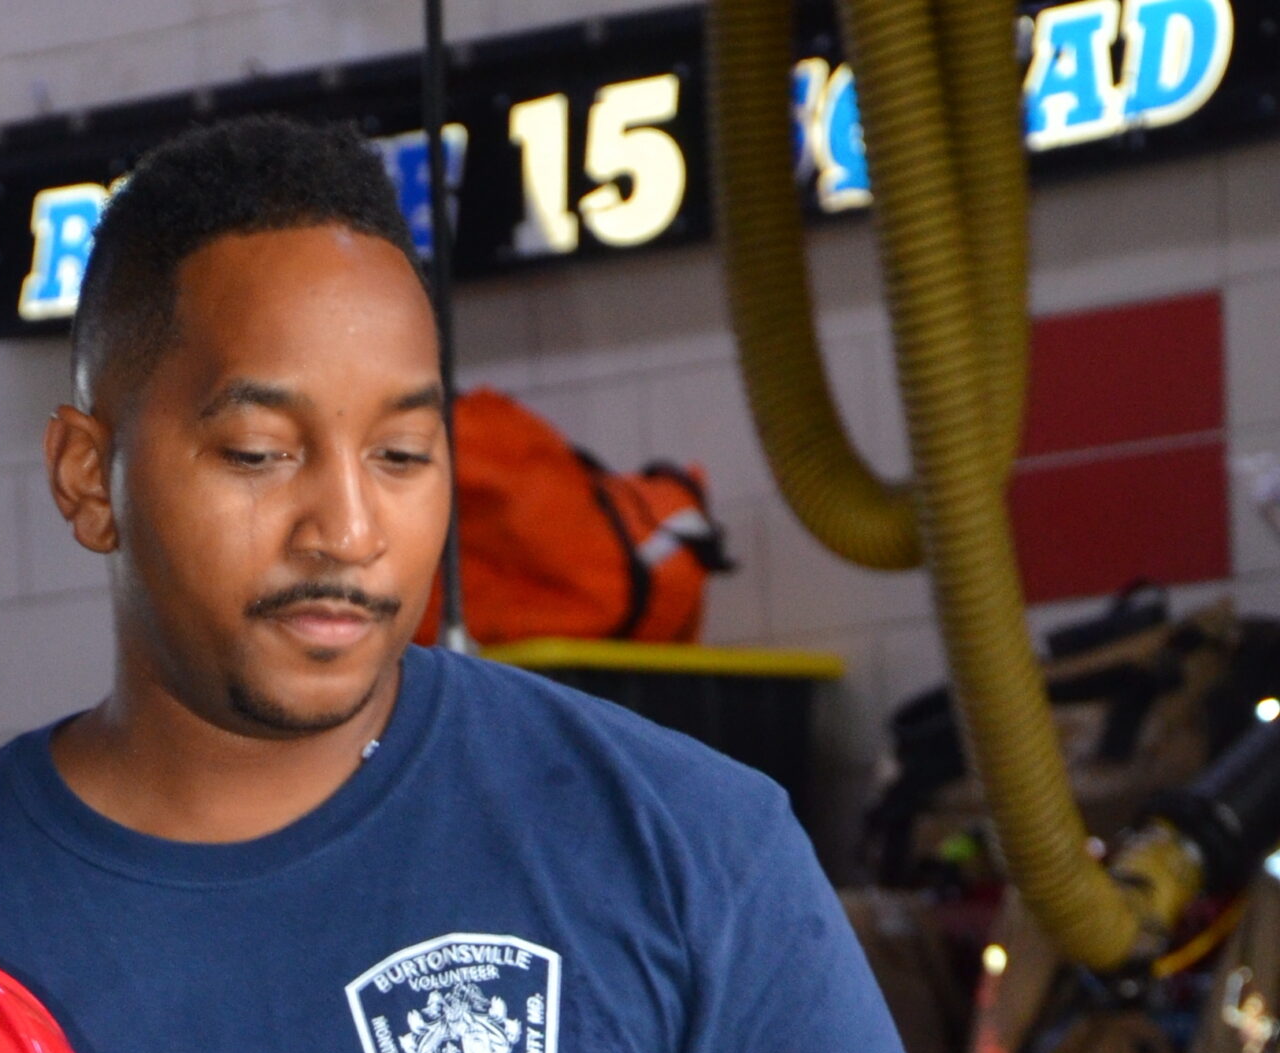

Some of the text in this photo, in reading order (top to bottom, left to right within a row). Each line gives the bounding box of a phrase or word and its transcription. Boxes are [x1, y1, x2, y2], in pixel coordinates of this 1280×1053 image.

[508, 73, 687, 257] 15
[373, 944, 533, 993] BURTONSVILLE
[408, 964, 500, 992] VOLUNTEER
